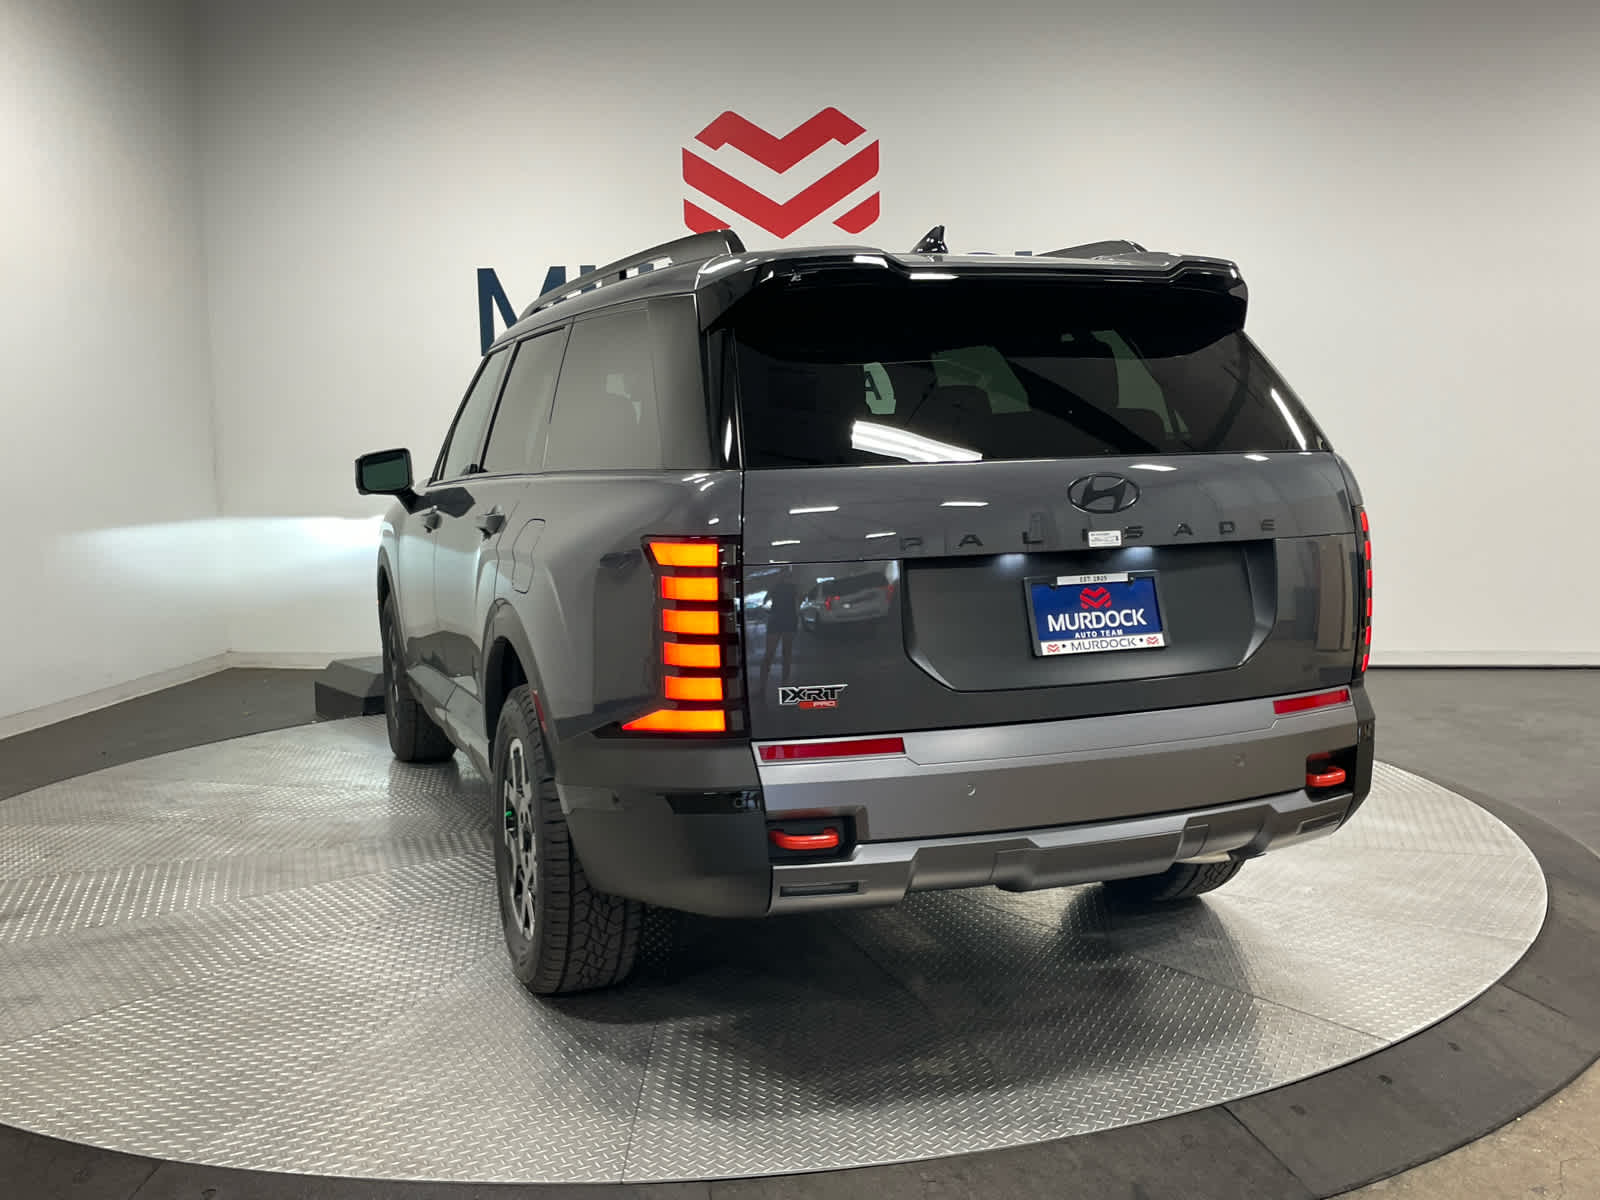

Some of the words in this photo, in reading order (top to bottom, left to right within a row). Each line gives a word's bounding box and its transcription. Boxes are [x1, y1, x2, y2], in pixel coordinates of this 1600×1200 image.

[1047, 608, 1147, 632] MURDOCK
[1100, 629, 1124, 637] TEAM
[1071, 638, 1137, 652] MURDOCK
